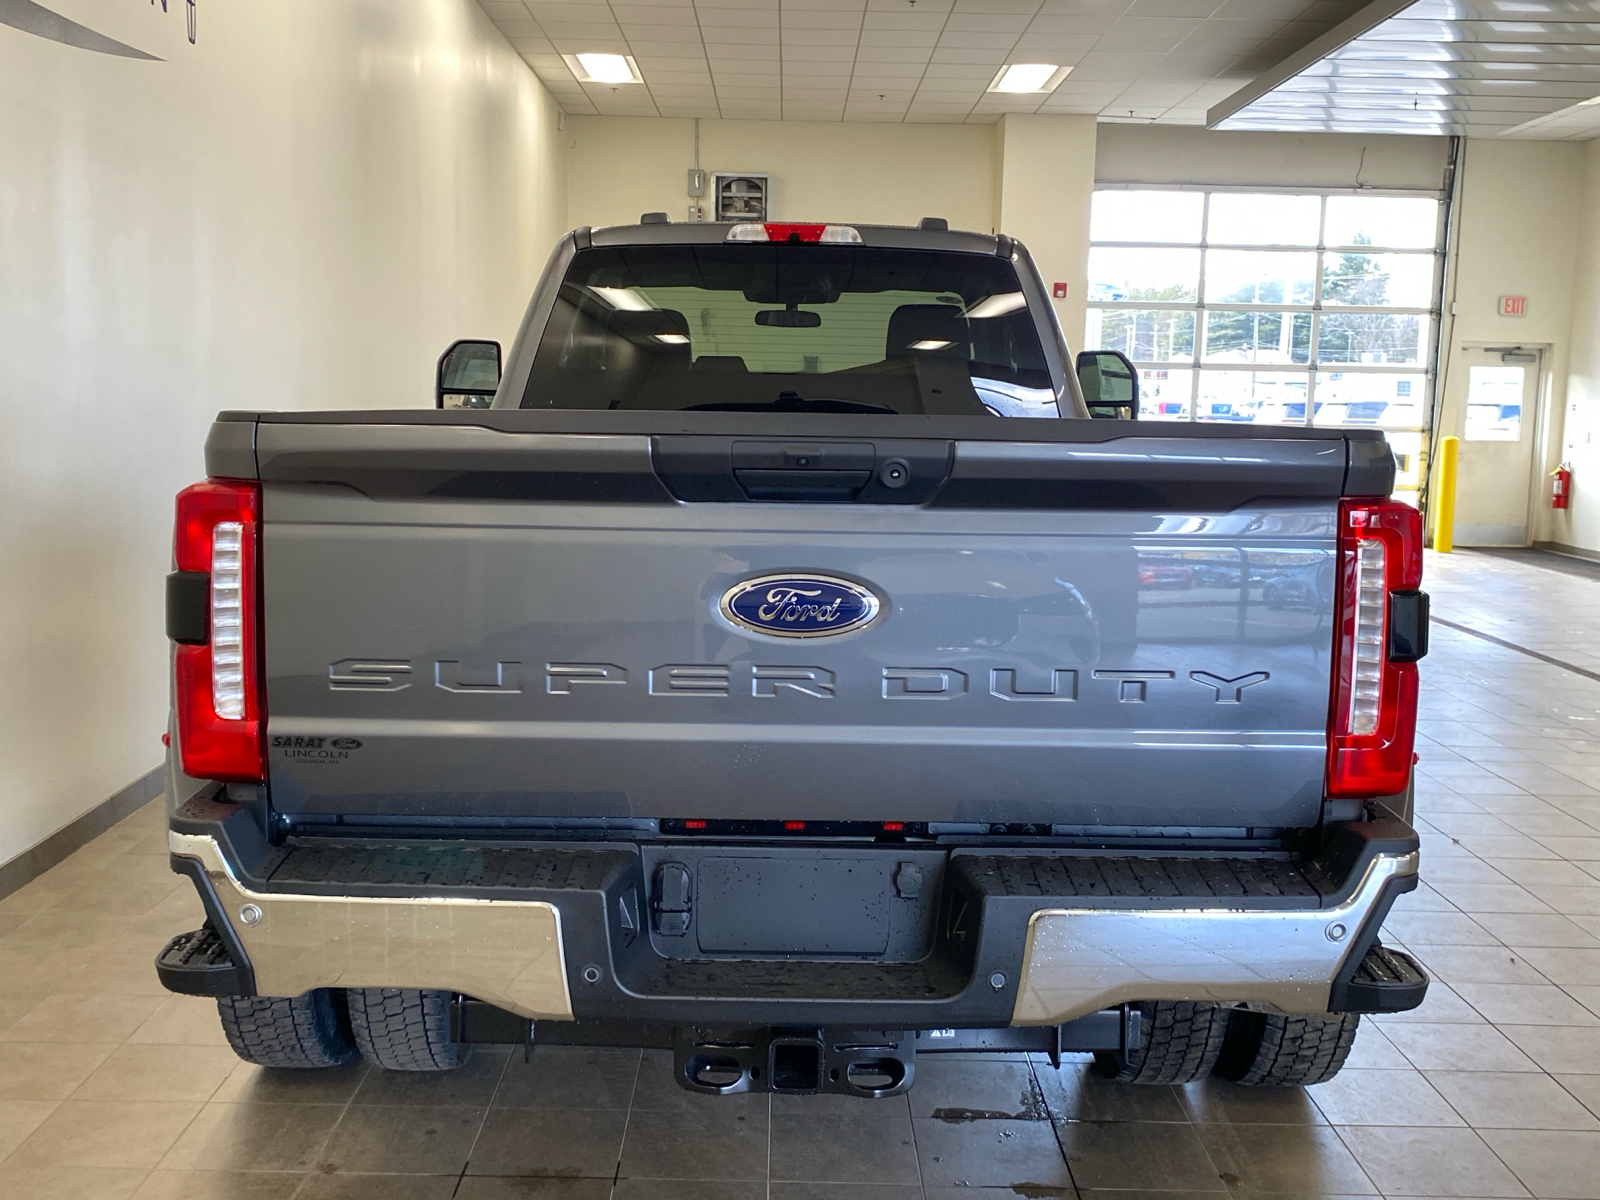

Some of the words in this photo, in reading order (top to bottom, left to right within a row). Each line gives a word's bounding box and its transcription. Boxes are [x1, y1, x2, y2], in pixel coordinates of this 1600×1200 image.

[1504, 297, 1525, 314] EXIT
[758, 587, 842, 622] Ford
[329, 658, 836, 698] SUPER
[881, 667, 1270, 704] DUTY
[272, 735, 326, 748] SARAT
[284, 749, 349, 759] LINCOLN
